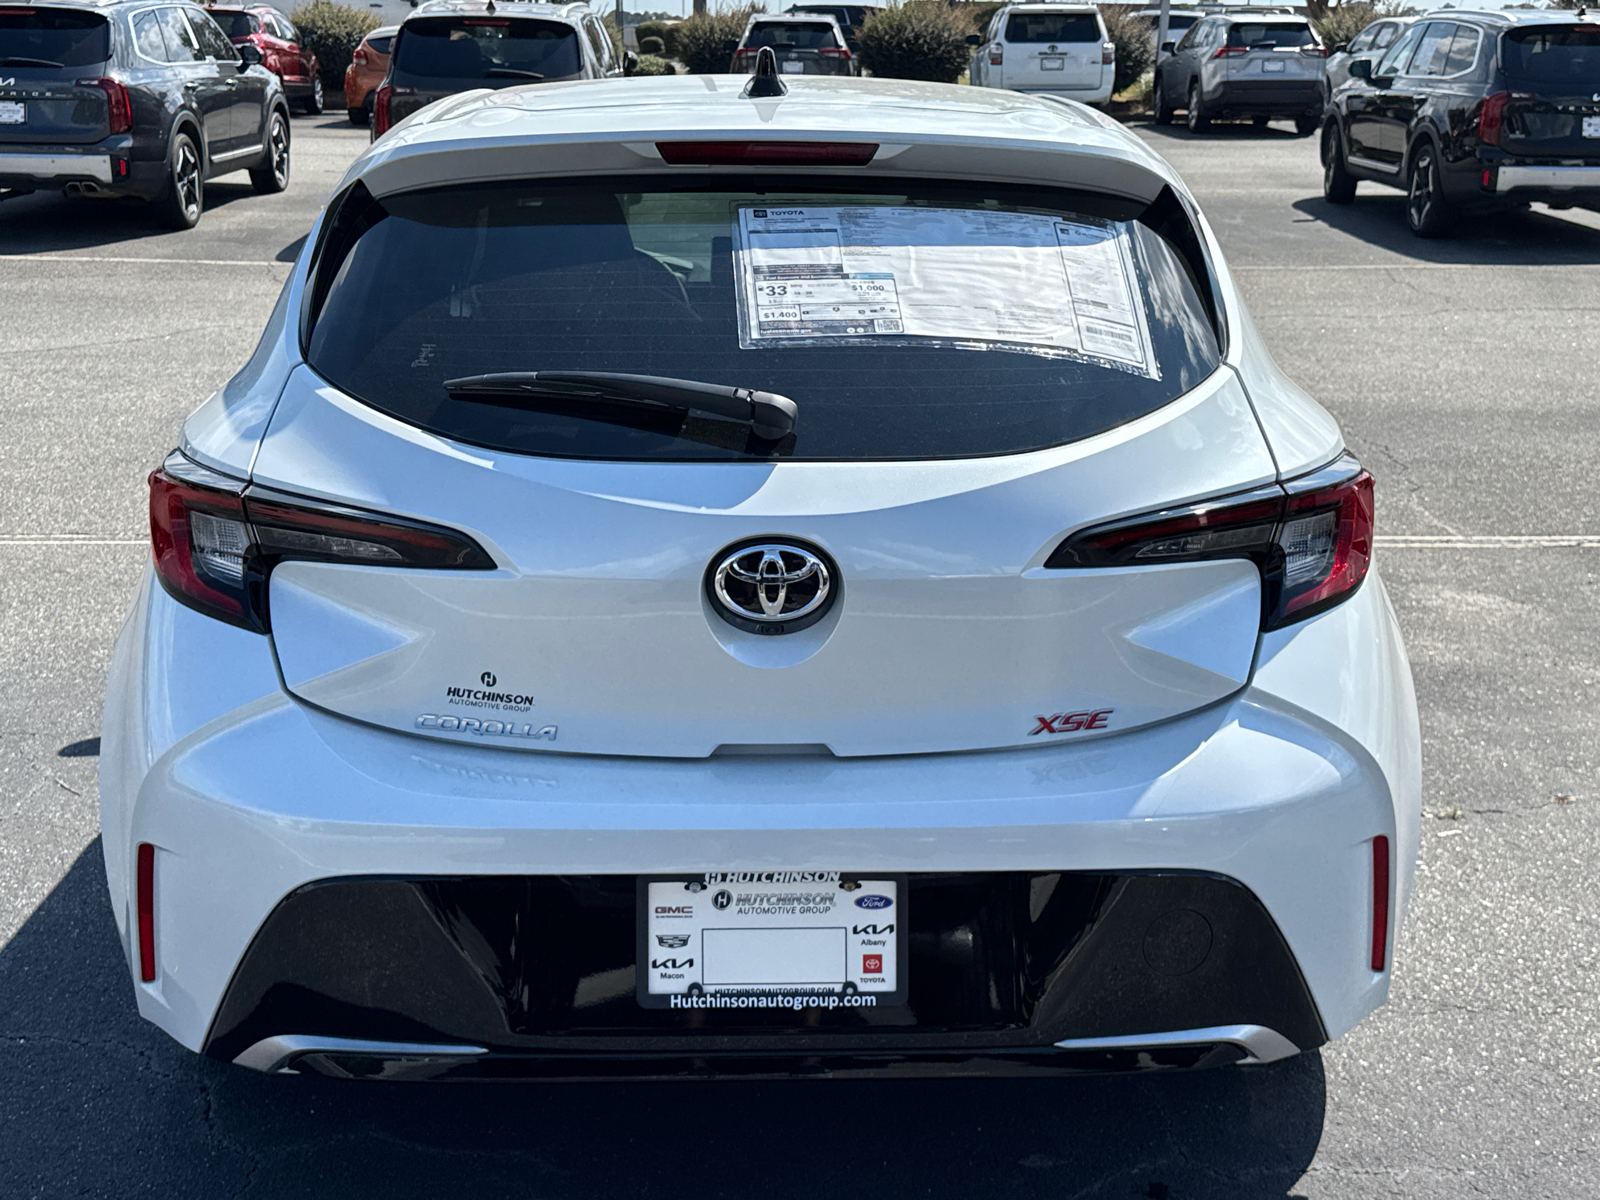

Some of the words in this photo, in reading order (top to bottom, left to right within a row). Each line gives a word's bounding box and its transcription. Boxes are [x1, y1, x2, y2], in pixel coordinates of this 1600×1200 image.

[765, 285, 788, 296] 33
[764, 311, 797, 319] $1,400
[446, 687, 534, 706] HUTCHINSON
[448, 698, 500, 710] AUTOMOTIVE
[502, 704, 531, 713] GROUP
[414, 713, 558, 741] COROLLA
[1027, 708, 1114, 735] XSE
[726, 872, 840, 884] HUTCHINSON
[735, 892, 834, 906] HUTCHINSON
[655, 906, 693, 914] GMC
[737, 906, 797, 915] AUTOMOTIVE
[799, 905, 831, 914] GROUP
[852, 924, 895, 935] KIA
[861, 939, 886, 947] Albany
[652, 958, 694, 969] KIA
[670, 993, 876, 1010] Hutchinsonautogroup.com
